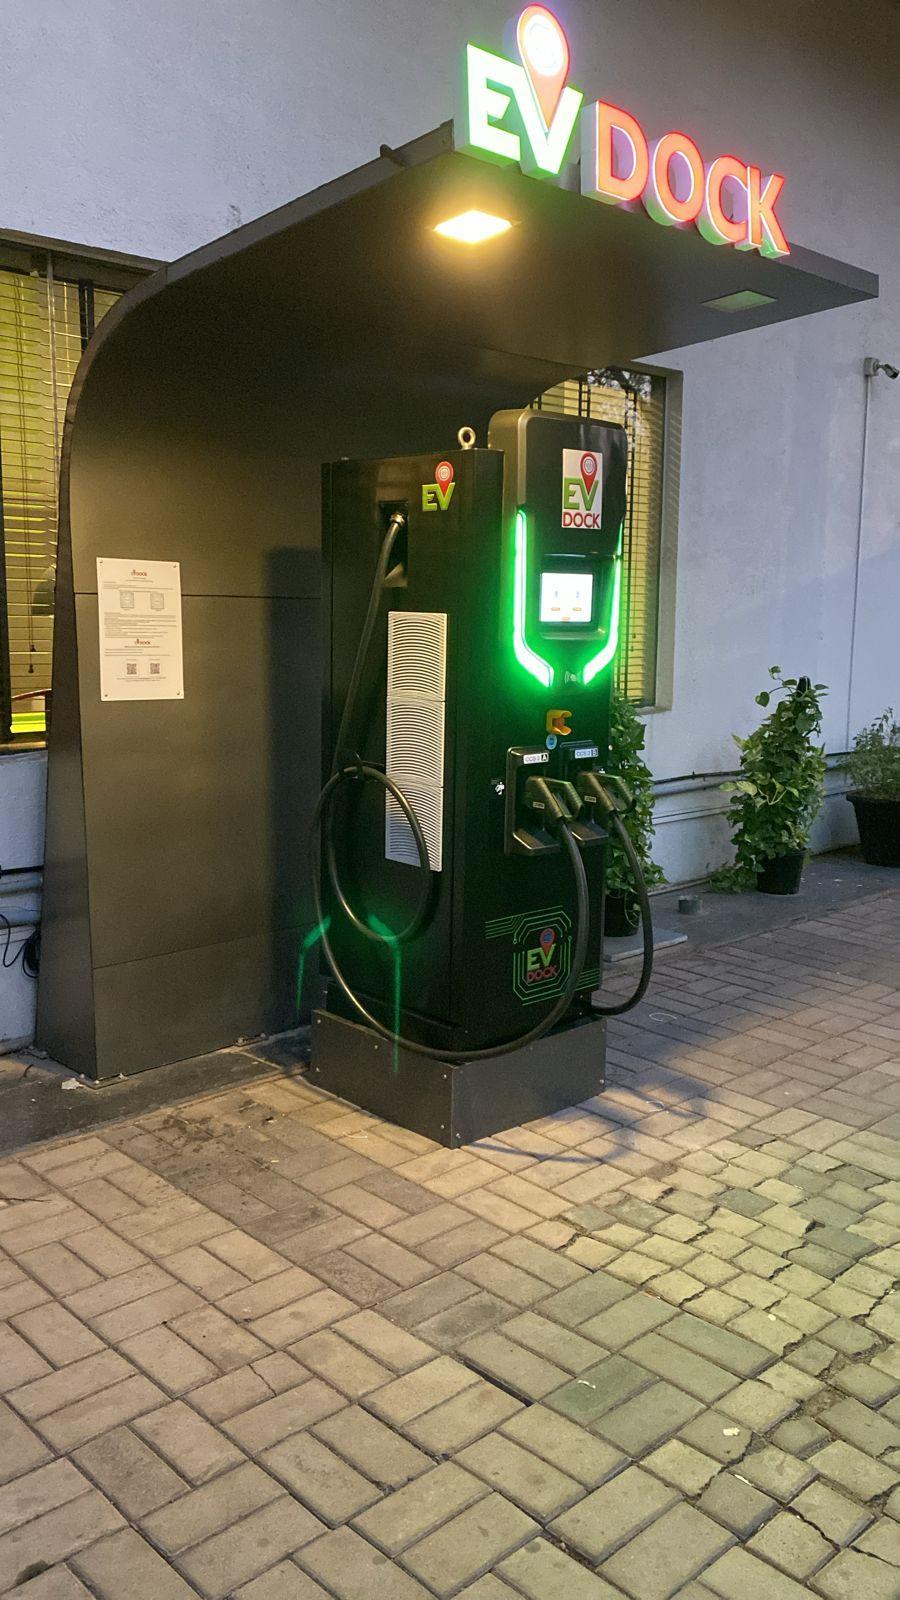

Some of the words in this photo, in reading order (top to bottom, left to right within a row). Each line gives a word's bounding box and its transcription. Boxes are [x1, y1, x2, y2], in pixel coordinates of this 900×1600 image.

[465, 43, 584, 177] EV
[591, 100, 791, 256] DOCK
[422, 482, 456, 511] EV
[564, 477, 599, 511] EV
[563, 512, 600, 528] DOCK
[527, 944, 556, 970] EV
[527, 965, 557, 982] DOCK
